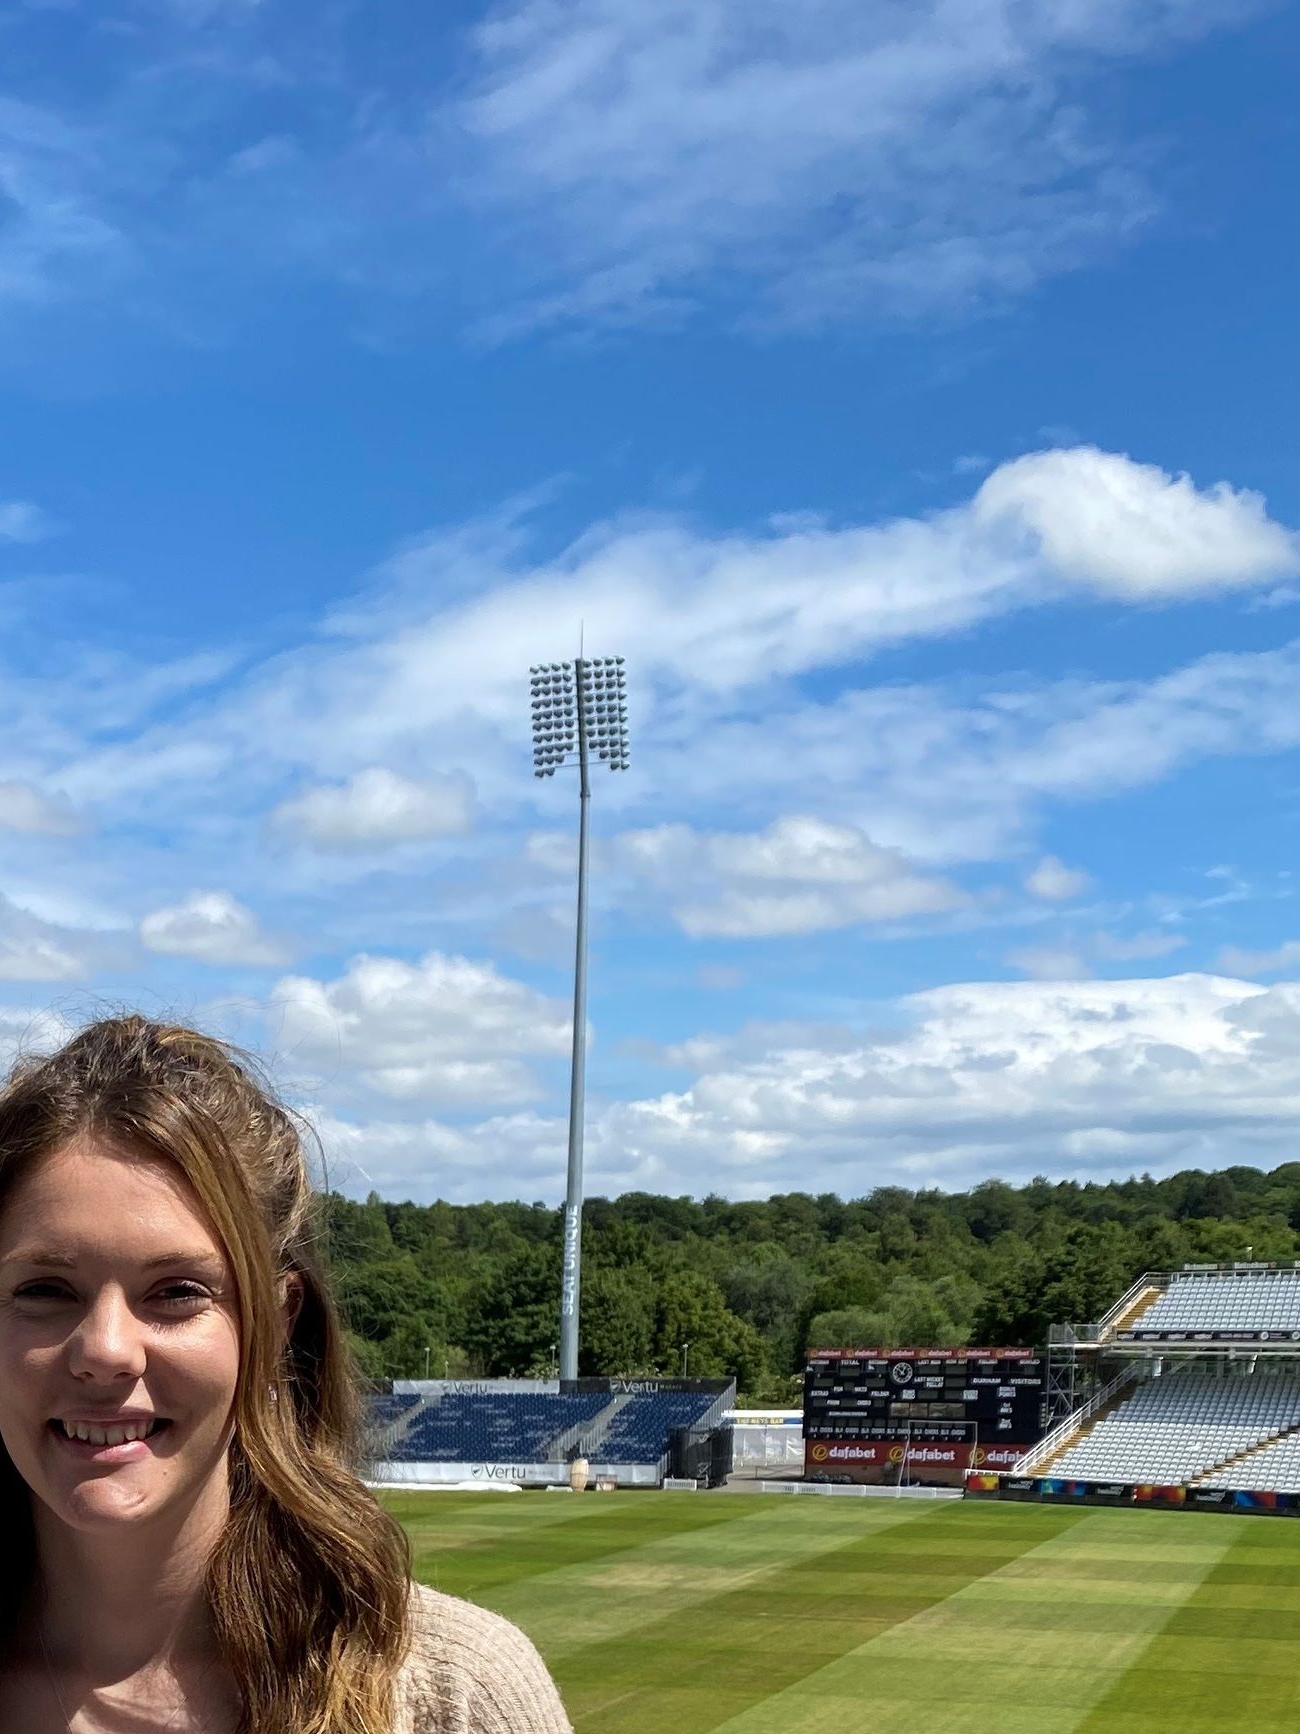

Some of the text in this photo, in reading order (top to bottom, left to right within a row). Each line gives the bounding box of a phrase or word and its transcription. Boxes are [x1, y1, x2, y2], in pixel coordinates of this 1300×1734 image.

[564, 1204, 578, 1269] UNIQUE
[453, 1382, 487, 1394] Vertu
[622, 1380, 659, 1393] Vertu
[829, 1446, 876, 1460] dafabet
[907, 1447, 955, 1461] dafabet
[485, 1464, 526, 1479] Vertu
